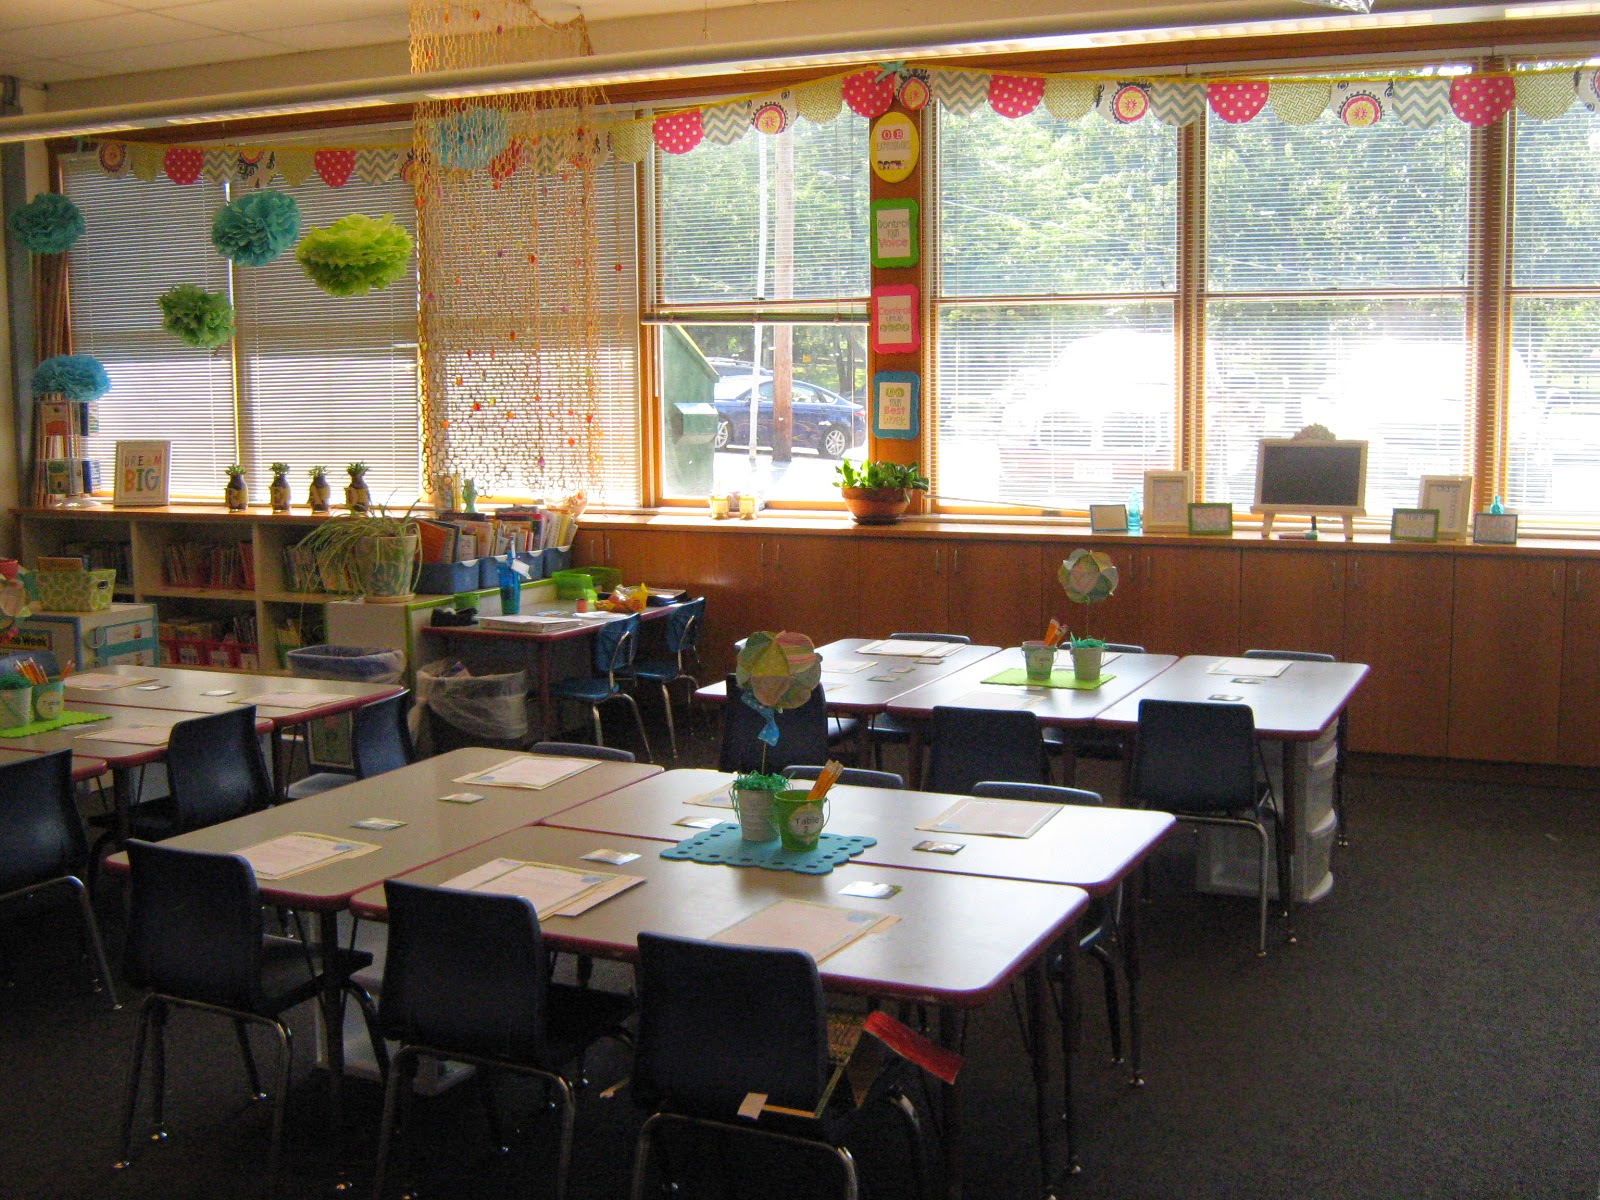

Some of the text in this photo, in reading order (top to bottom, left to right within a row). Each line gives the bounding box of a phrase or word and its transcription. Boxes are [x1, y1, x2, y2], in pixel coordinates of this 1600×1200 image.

[124, 455, 162, 468] DREAM
[124, 468, 160, 493] BIG
[795, 817, 820, 825] Table
